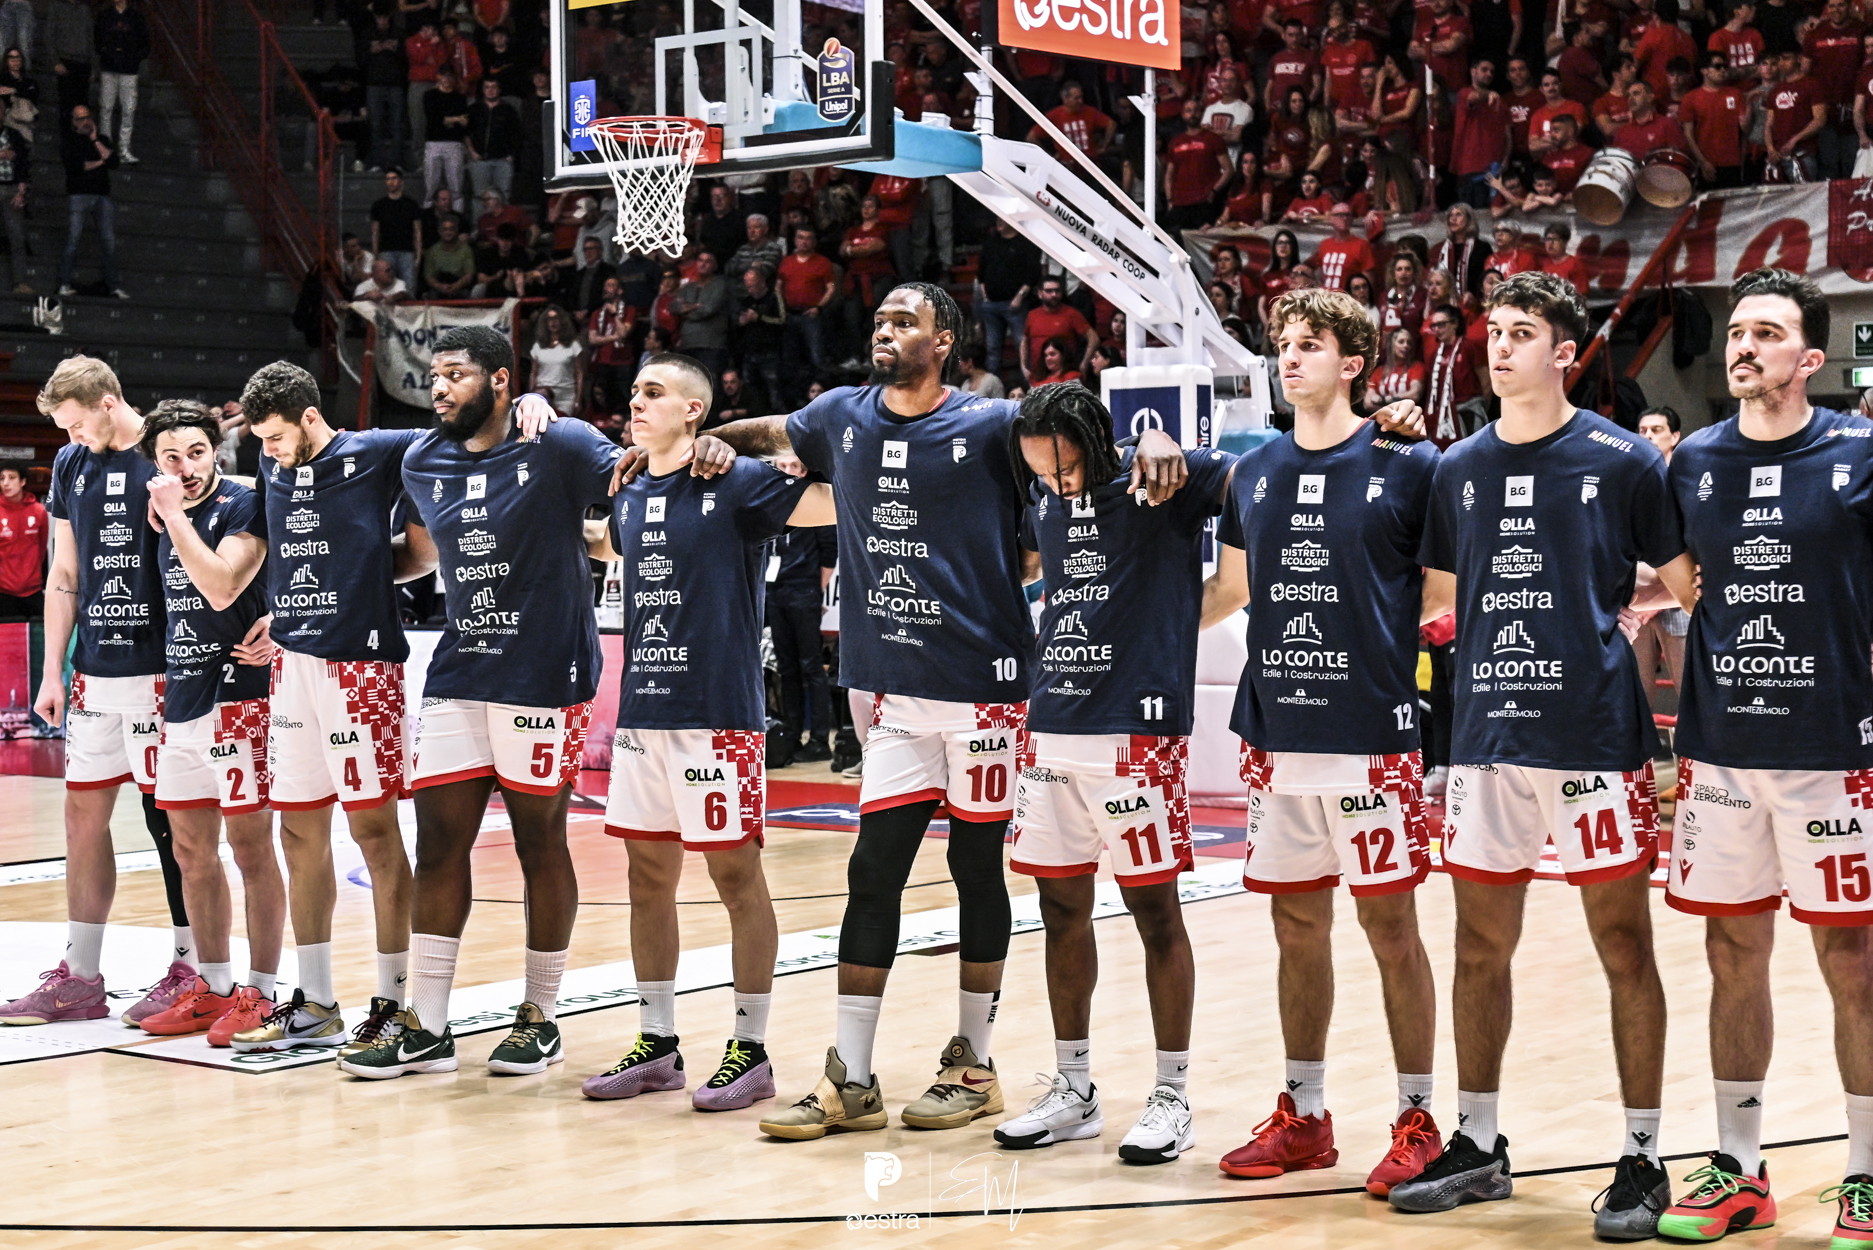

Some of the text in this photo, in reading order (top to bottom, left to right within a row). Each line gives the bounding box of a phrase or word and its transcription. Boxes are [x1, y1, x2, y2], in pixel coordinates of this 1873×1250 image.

[822, 71, 850, 86] LBA
[825, 99, 848, 113] Unipol
[1054, 205, 1145, 280] NUOVA RADAR COOP
[1371, 438, 1414, 456] MANUEL
[1587, 430, 1634, 453] MANUEL
[887, 450, 901, 459] B.G
[470, 483, 482, 492] B.G
[878, 476, 909, 490] OLLA
[1755, 476, 1773, 487] B.G
[1302, 484, 1318, 494] B.G
[1510, 486, 1526, 497] B.G
[104, 502, 126, 512] OLLA
[461, 506, 488, 519] OLLA
[649, 505, 660, 514] B.G
[872, 506, 918, 518] DISTRETTI
[286, 514, 319, 523] DISTRETTI
[873, 515, 917, 526] ECOLOGICI
[1291, 513, 1324, 527] OLLA
[1743, 507, 1783, 522] OLLA
[100, 527, 132, 535] DISTRETTI
[286, 521, 319, 529] ECOLOGICI
[1068, 524, 1098, 538] OLLA
[1500, 517, 1535, 532] OLLA
[100, 535, 132, 543] ECOLOGICI
[458, 535, 495, 545] DISTRETTI
[642, 531, 667, 543] OLLA
[291, 540, 330, 556] estra
[460, 542, 496, 552] ECOLOGICI
[879, 538, 929, 558] estra
[1281, 548, 1329, 558] DISTRETTI
[1733, 544, 1791, 556] DISTRETTI
[104, 554, 141, 569] estra
[638, 560, 673, 568] DISTRETTI
[1063, 555, 1106, 567] DISTRETTI
[1281, 556, 1329, 566] ECOLOGICI
[1492, 553, 1542, 565] DISTRETTI
[1734, 554, 1791, 565] ECOLOGICI
[467, 561, 510, 581] estra
[639, 568, 673, 576] ECOLOGICI
[1064, 563, 1106, 575] ECOLOGICI
[1492, 563, 1542, 574] ECOLOGICI
[643, 588, 682, 606] estra
[868, 589, 885, 606] LO
[1064, 583, 1109, 602] estra
[1285, 581, 1339, 602] estra
[1496, 587, 1553, 610] estra
[1741, 580, 1806, 604] estra
[172, 597, 204, 611] estra
[275, 592, 337, 608] LO CONTE
[88, 604, 149, 617] LO CONTE
[297, 607, 337, 617] Costruzioni
[867, 606, 886, 618] Edile
[367, 630, 379, 650] 4
[881, 633, 923, 647] MONTEZEMOLO
[459, 646, 502, 655] MONTEZEMOLO
[641, 647, 688, 662] CONTE
[1055, 644, 1112, 661] CONTE
[1262, 649, 1348, 668] LO CONTE
[1712, 654, 1815, 674] LO CONTE
[222, 663, 236, 683] 2
[643, 664, 688, 673] Costruzioni
[992, 657, 1017, 682] 10
[1060, 663, 1111, 672] Costruzioni
[1473, 660, 1563, 680] LO CONTE
[1262, 669, 1348, 681] Edile Costruzioni
[1746, 676, 1815, 688] Costruzioni
[1048, 687, 1091, 695] MONTEZEMOLO
[1472, 681, 1563, 693] Edile Costruzioni
[1277, 696, 1328, 706] MONTEZEMOLO
[1140, 696, 1163, 721] 11
[1487, 709, 1541, 718] MONTEZEMOLO
[1727, 705, 1790, 715] MONTEZEMOLO
[514, 715, 556, 730] OLLA
[1392, 702, 1414, 731] 12
[330, 730, 359, 745] OLLA
[969, 736, 1008, 753] OLLA
[210, 743, 238, 758] OLLA
[530, 743, 554, 778] 5
[344, 756, 362, 791] 4
[685, 768, 725, 781] OLLA
[1022, 771, 1069, 784] ZEROCENTO
[226, 767, 246, 801] 2
[966, 763, 1007, 802] 10
[1561, 775, 1608, 798] OLLA
[1694, 784, 1729, 798] SPAZIO
[1105, 796, 1150, 815] OLLA
[1340, 793, 1387, 813] OLLA
[1694, 792, 1751, 809] ZEROCENTO
[705, 791, 727, 831] 6
[1342, 810, 1388, 818] HOMESOLUTION
[1574, 808, 1624, 859] 14
[1807, 818, 1863, 837] OLLA
[1121, 822, 1162, 867] 11
[1808, 836, 1863, 844] HOMESOLUTION
[1350, 827, 1398, 875] 12
[1814, 853, 1872, 902] 15
[987, 1004, 998, 1024] NIKE
